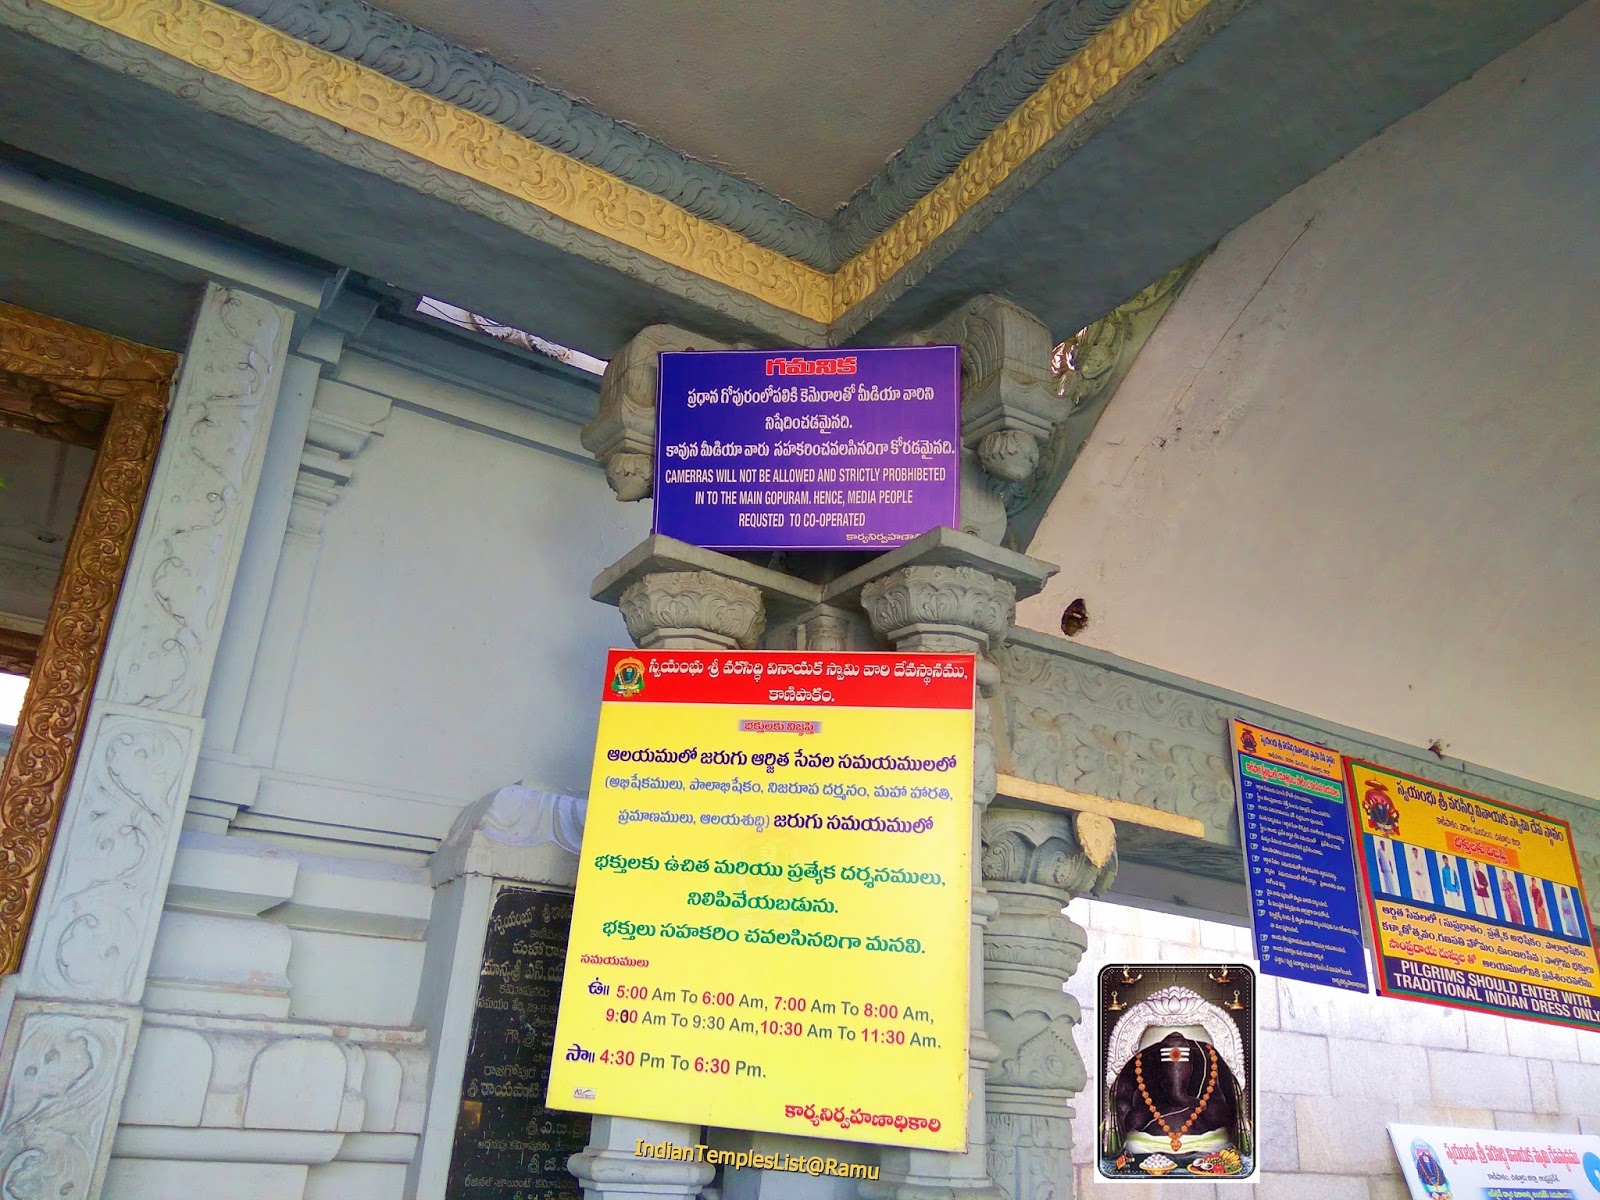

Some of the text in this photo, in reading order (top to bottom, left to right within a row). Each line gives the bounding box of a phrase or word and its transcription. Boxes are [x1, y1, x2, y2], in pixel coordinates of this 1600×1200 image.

[765, 357, 857, 376] గమనిక
[687, 383, 935, 408] ప్రధాన గోపురంలోపలికి కెమెరాలతో మీడియా వారిని
[666, 441, 699, 460] కావున
[700, 440, 743, 457] మీడియా
[744, 441, 770, 457] వారు
[665, 467, 946, 484] CAMERRAS WILL NOT BE ALLOWED AND STRICTLY PROBHIBETED
[695, 490, 913, 506] IN TO THE MAIN GOPURAM. HENCE, MEDIA PEOPLE
[738, 512, 866, 528] REQUSTED TO CO-OPERATED
[649, 658, 704, 678] స్వయంభు
[707, 658, 720, 678] శ్రీ
[766, 661, 823, 676] వినాయక
[826, 661, 860, 681] స్వామి
[863, 664, 891, 677] వారి
[607, 747, 957, 774] ఆలయములో జరుగు ఆర్జిత సేవల సమయములలో
[873, 784, 907, 798] మహా
[773, 813, 823, 830] జరుగు
[826, 814, 934, 835] సమయములో
[594, 854, 660, 874] భక్తులకు
[664, 855, 710, 873] ఉచిత
[714, 860, 783, 877] మరియు
[787, 860, 837, 885] ప్రత్యేక
[602, 920, 656, 941] భక్తులు
[580, 953, 650, 968] సమయములు
[1401, 960, 1592, 1008] PILGRIMS SHOULD ENTER WITH
[616, 985, 648, 1000] 5:00
[651, 987, 676, 1002] Am
[681, 989, 698, 1004] To
[702, 991, 735, 1007] 6:00
[738, 994, 768, 1011] Am,
[774, 996, 806, 1012] 7:00
[810, 999, 836, 1014] Am
[841, 1001, 859, 1016] To
[863, 1003, 898, 1019] 8:00
[902, 1006, 934, 1025] Am,
[1393, 973, 1600, 1023] TRADITIONAL INDIAN DRESS ONLY
[641, 1010, 666, 1026] Am
[671, 1013, 688, 1027] To
[692, 1014, 725, 1030] 9:30
[807, 1024, 832, 1039] Am
[837, 1025, 856, 1041] To
[861, 1028, 905, 1045] 11:30
[909, 1032, 941, 1049] Am.
[599, 1049, 635, 1066] 4:30
[639, 1052, 665, 1069] Pm
[671, 1055, 690, 1071] To
[694, 1057, 730, 1074] 6:30
[735, 1060, 766, 1078] Pm.
